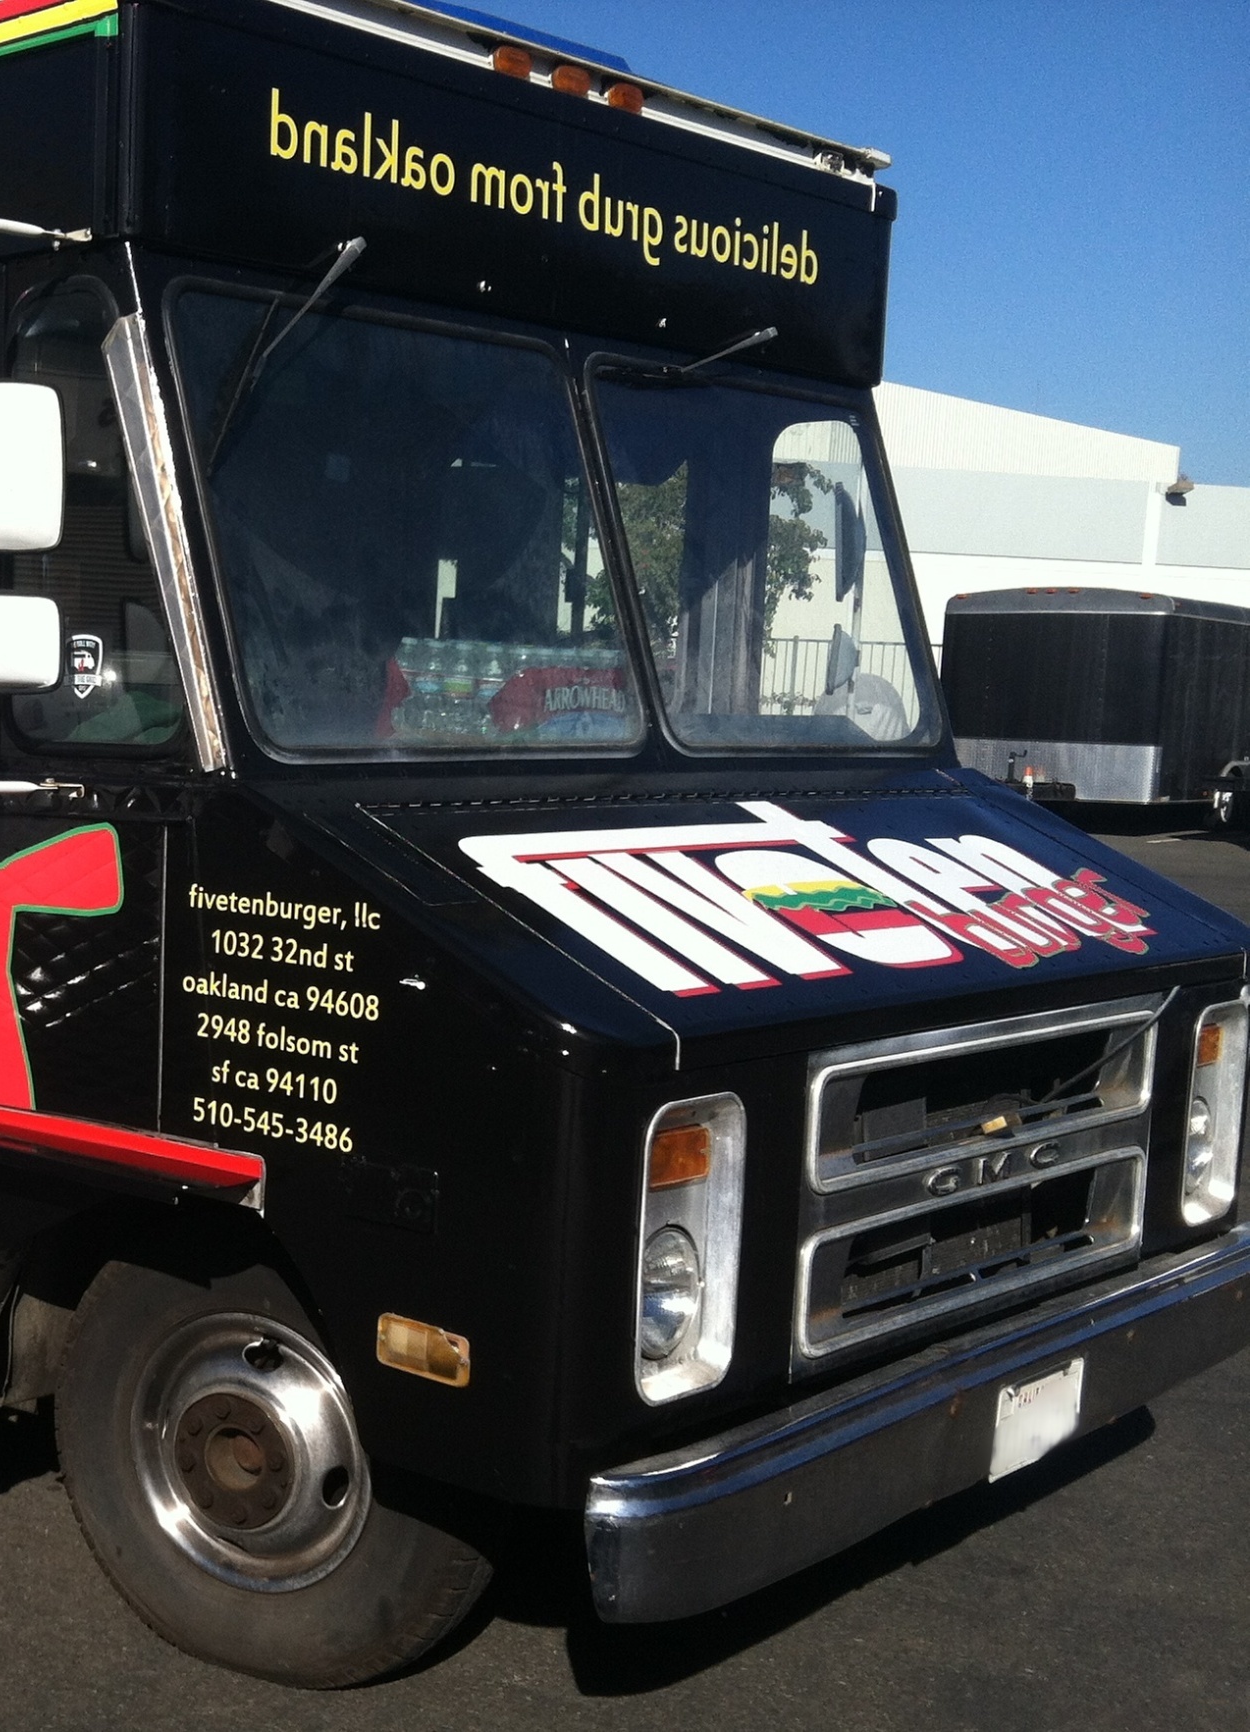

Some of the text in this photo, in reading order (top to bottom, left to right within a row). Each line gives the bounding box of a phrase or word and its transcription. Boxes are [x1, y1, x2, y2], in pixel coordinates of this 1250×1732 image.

[543, 684, 626, 712] ARROWHEAD
[188, 882, 381, 931] fivetenburger, llc
[212, 929, 355, 972] 1032 32nd st
[182, 971, 380, 1021] oakland ca 94608
[197, 1013, 360, 1064] 2948 folsom st
[212, 1060, 337, 1104] sf ca 94110
[193, 1097, 354, 1153] 510-545-3486
[925, 1140, 1061, 1198] GMC
